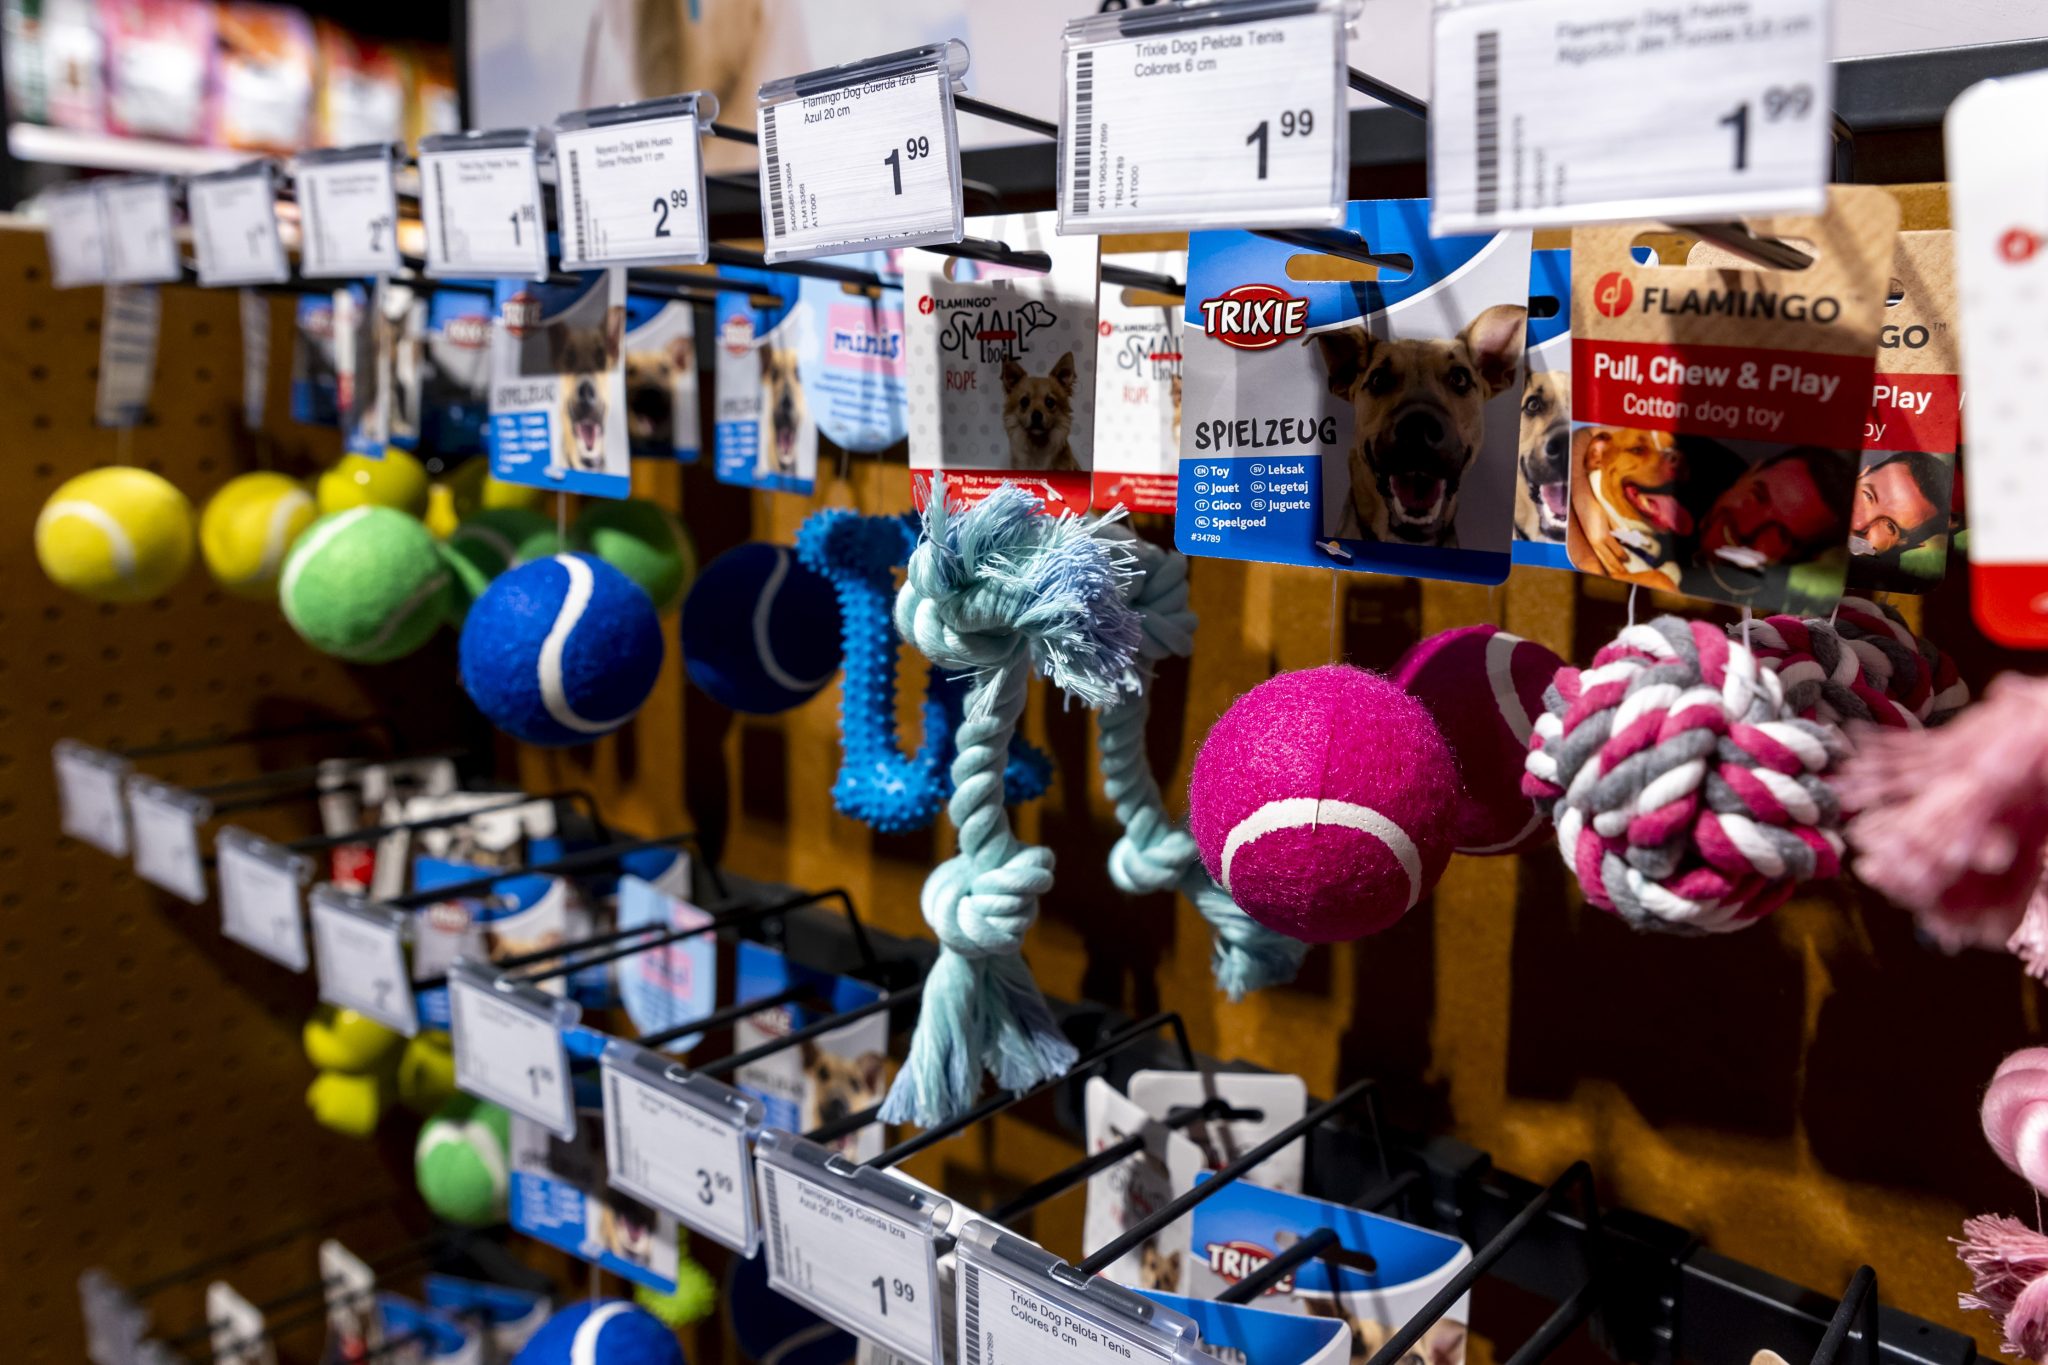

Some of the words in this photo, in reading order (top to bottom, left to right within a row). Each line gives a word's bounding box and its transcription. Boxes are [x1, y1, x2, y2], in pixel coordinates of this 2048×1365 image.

[1135, 41, 1168, 58] Trixie
[1171, 38, 1198, 56] Dog
[1201, 33, 1244, 51] Pelota
[1248, 29, 1285, 45] Tenis
[1134, 61, 1182, 78] Colores
[1185, 58, 1194, 72] 6
[1196, 58, 1217, 71] cm
[802, 91, 841, 109] Flamingo
[843, 87, 861, 100] Dog
[862, 79, 897, 96] Cuerda
[804, 109, 823, 125] Azul
[824, 107, 835, 120] 20
[836, 105, 851, 117] cm
[1641, 287, 1840, 325] FLAMINGO
[1202, 299, 1309, 336] TRIXIE
[946, 370, 977, 391] ROPE
[1594, 352, 1645, 386] Pull,
[1649, 356, 1728, 388] Chew
[1736, 362, 1761, 390] &
[1769, 361, 1841, 402] Play
[1872, 385, 1933, 415] Play
[1622, 392, 1690, 420] Cotton
[1695, 402, 1739, 427] dog
[1746, 406, 1784, 432] toy
[1195, 416, 1337, 452] SPIELZEUG
[1211, 466, 1230, 478] Toy
[1268, 464, 1305, 475] Leksak
[1210, 483, 1240, 495] Jouet
[1268, 481, 1309, 494] Legetøj
[1211, 501, 1242, 511] Gioco
[1267, 500, 1311, 513] Juguete
[1212, 516, 1267, 530] Speelgoed
[1190, 533, 1221, 543] #34789
[1011, 1289, 1037, 1312] Trixie
[1040, 1305, 1061, 1327] Dog
[1064, 1316, 1098, 1343] Pelota
[1101, 1334, 1131, 1359] Tenis
[1011, 1304, 1049, 1333] Colores
[1052, 1327, 1059, 1337] 6
[1061, 1332, 1078, 1348] cm
